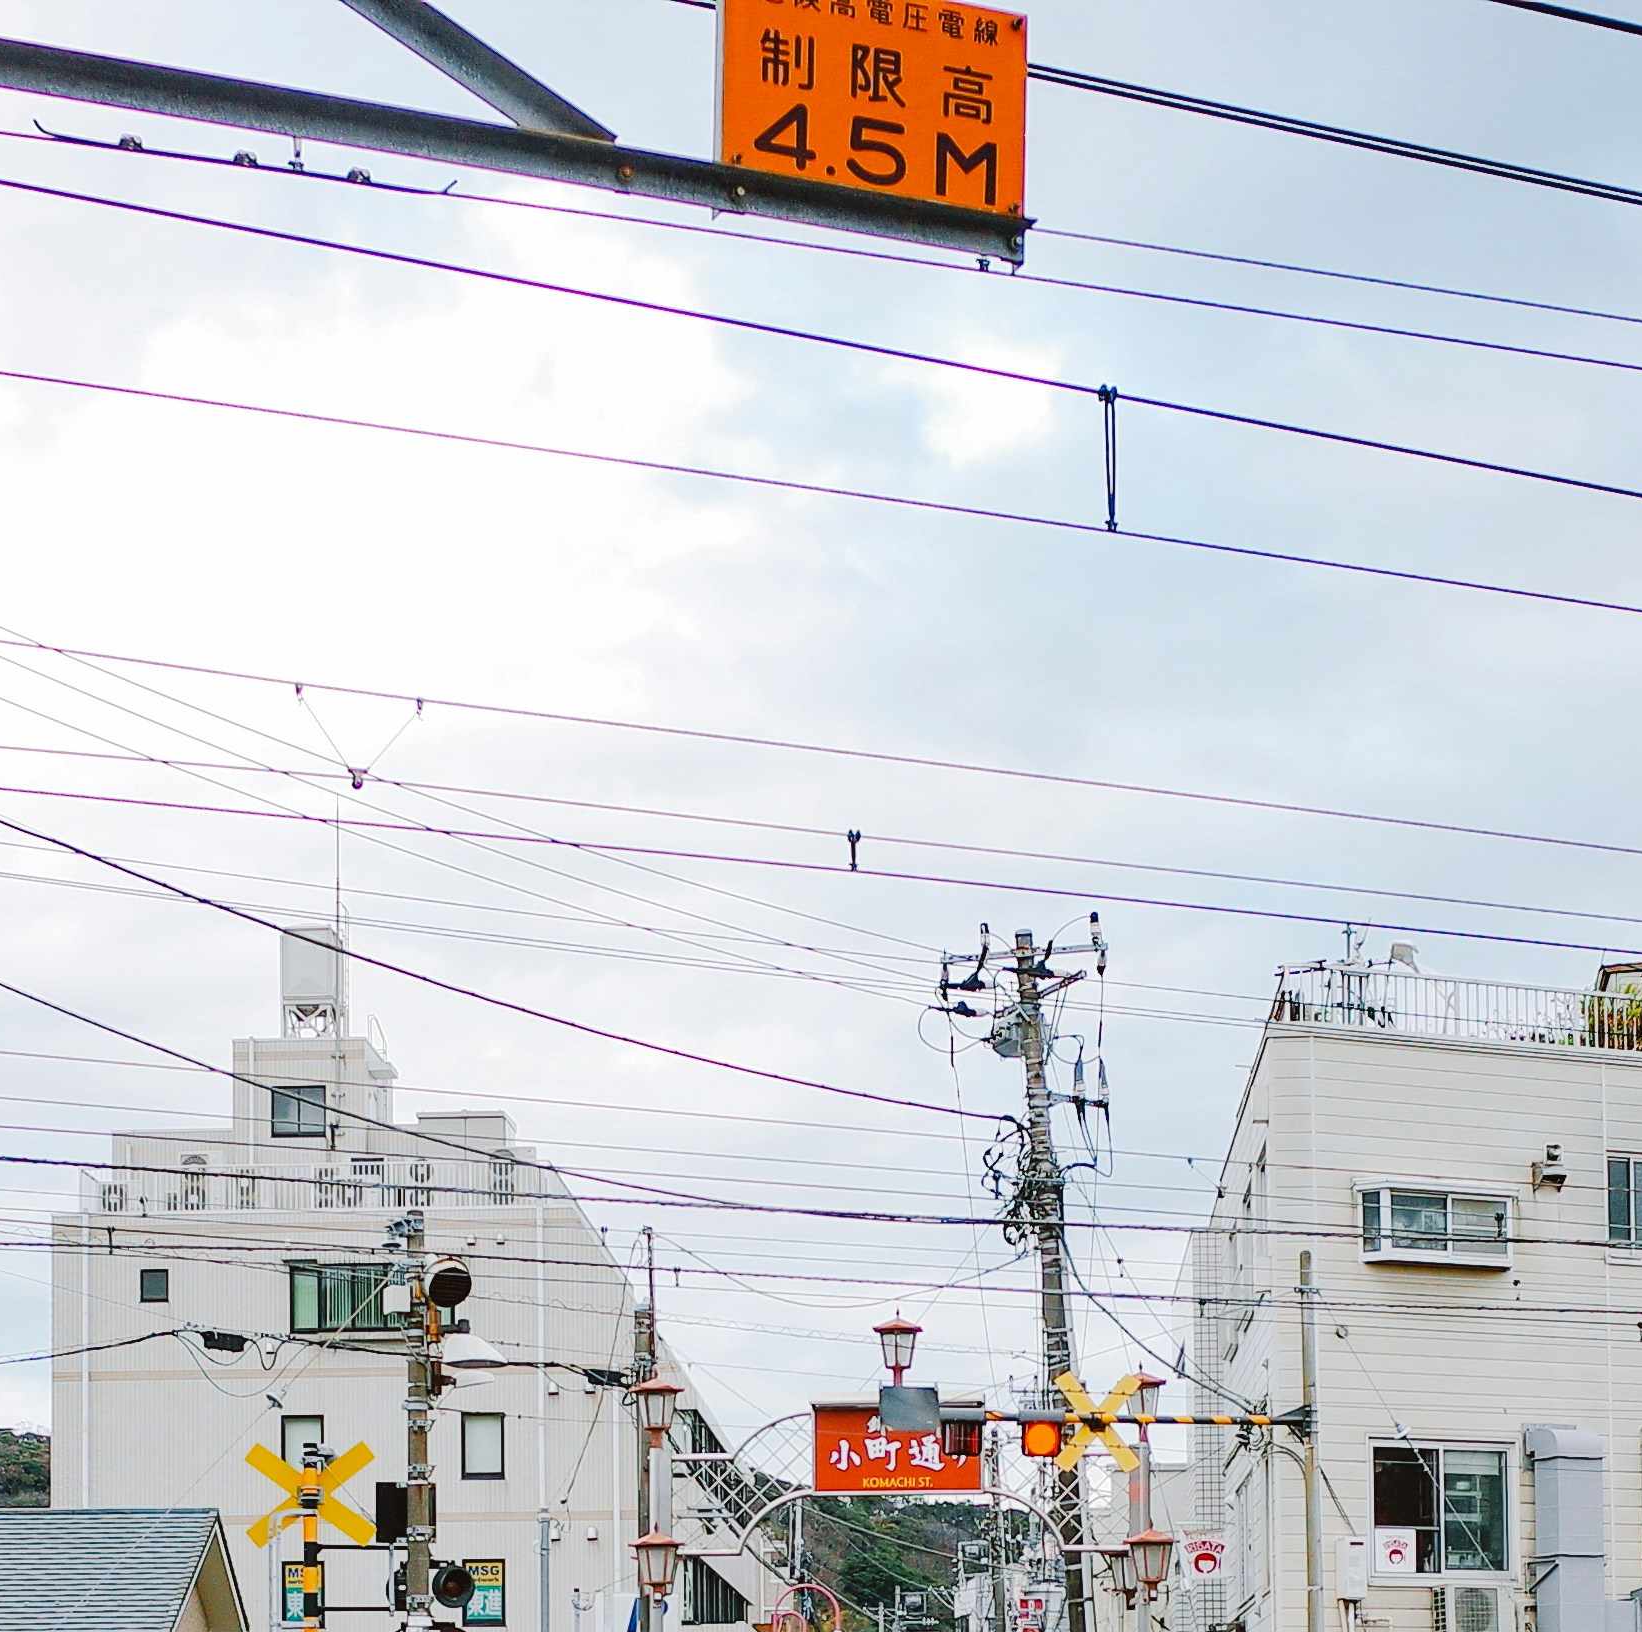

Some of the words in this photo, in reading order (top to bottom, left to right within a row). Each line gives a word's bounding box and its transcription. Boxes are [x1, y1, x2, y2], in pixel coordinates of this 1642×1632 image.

[759, 28, 993, 125] 制限高
[753, 103, 998, 206] 4.5M
[862, 1476, 916, 1489] KOMACHI
[918, 1476, 934, 1489] ST.
